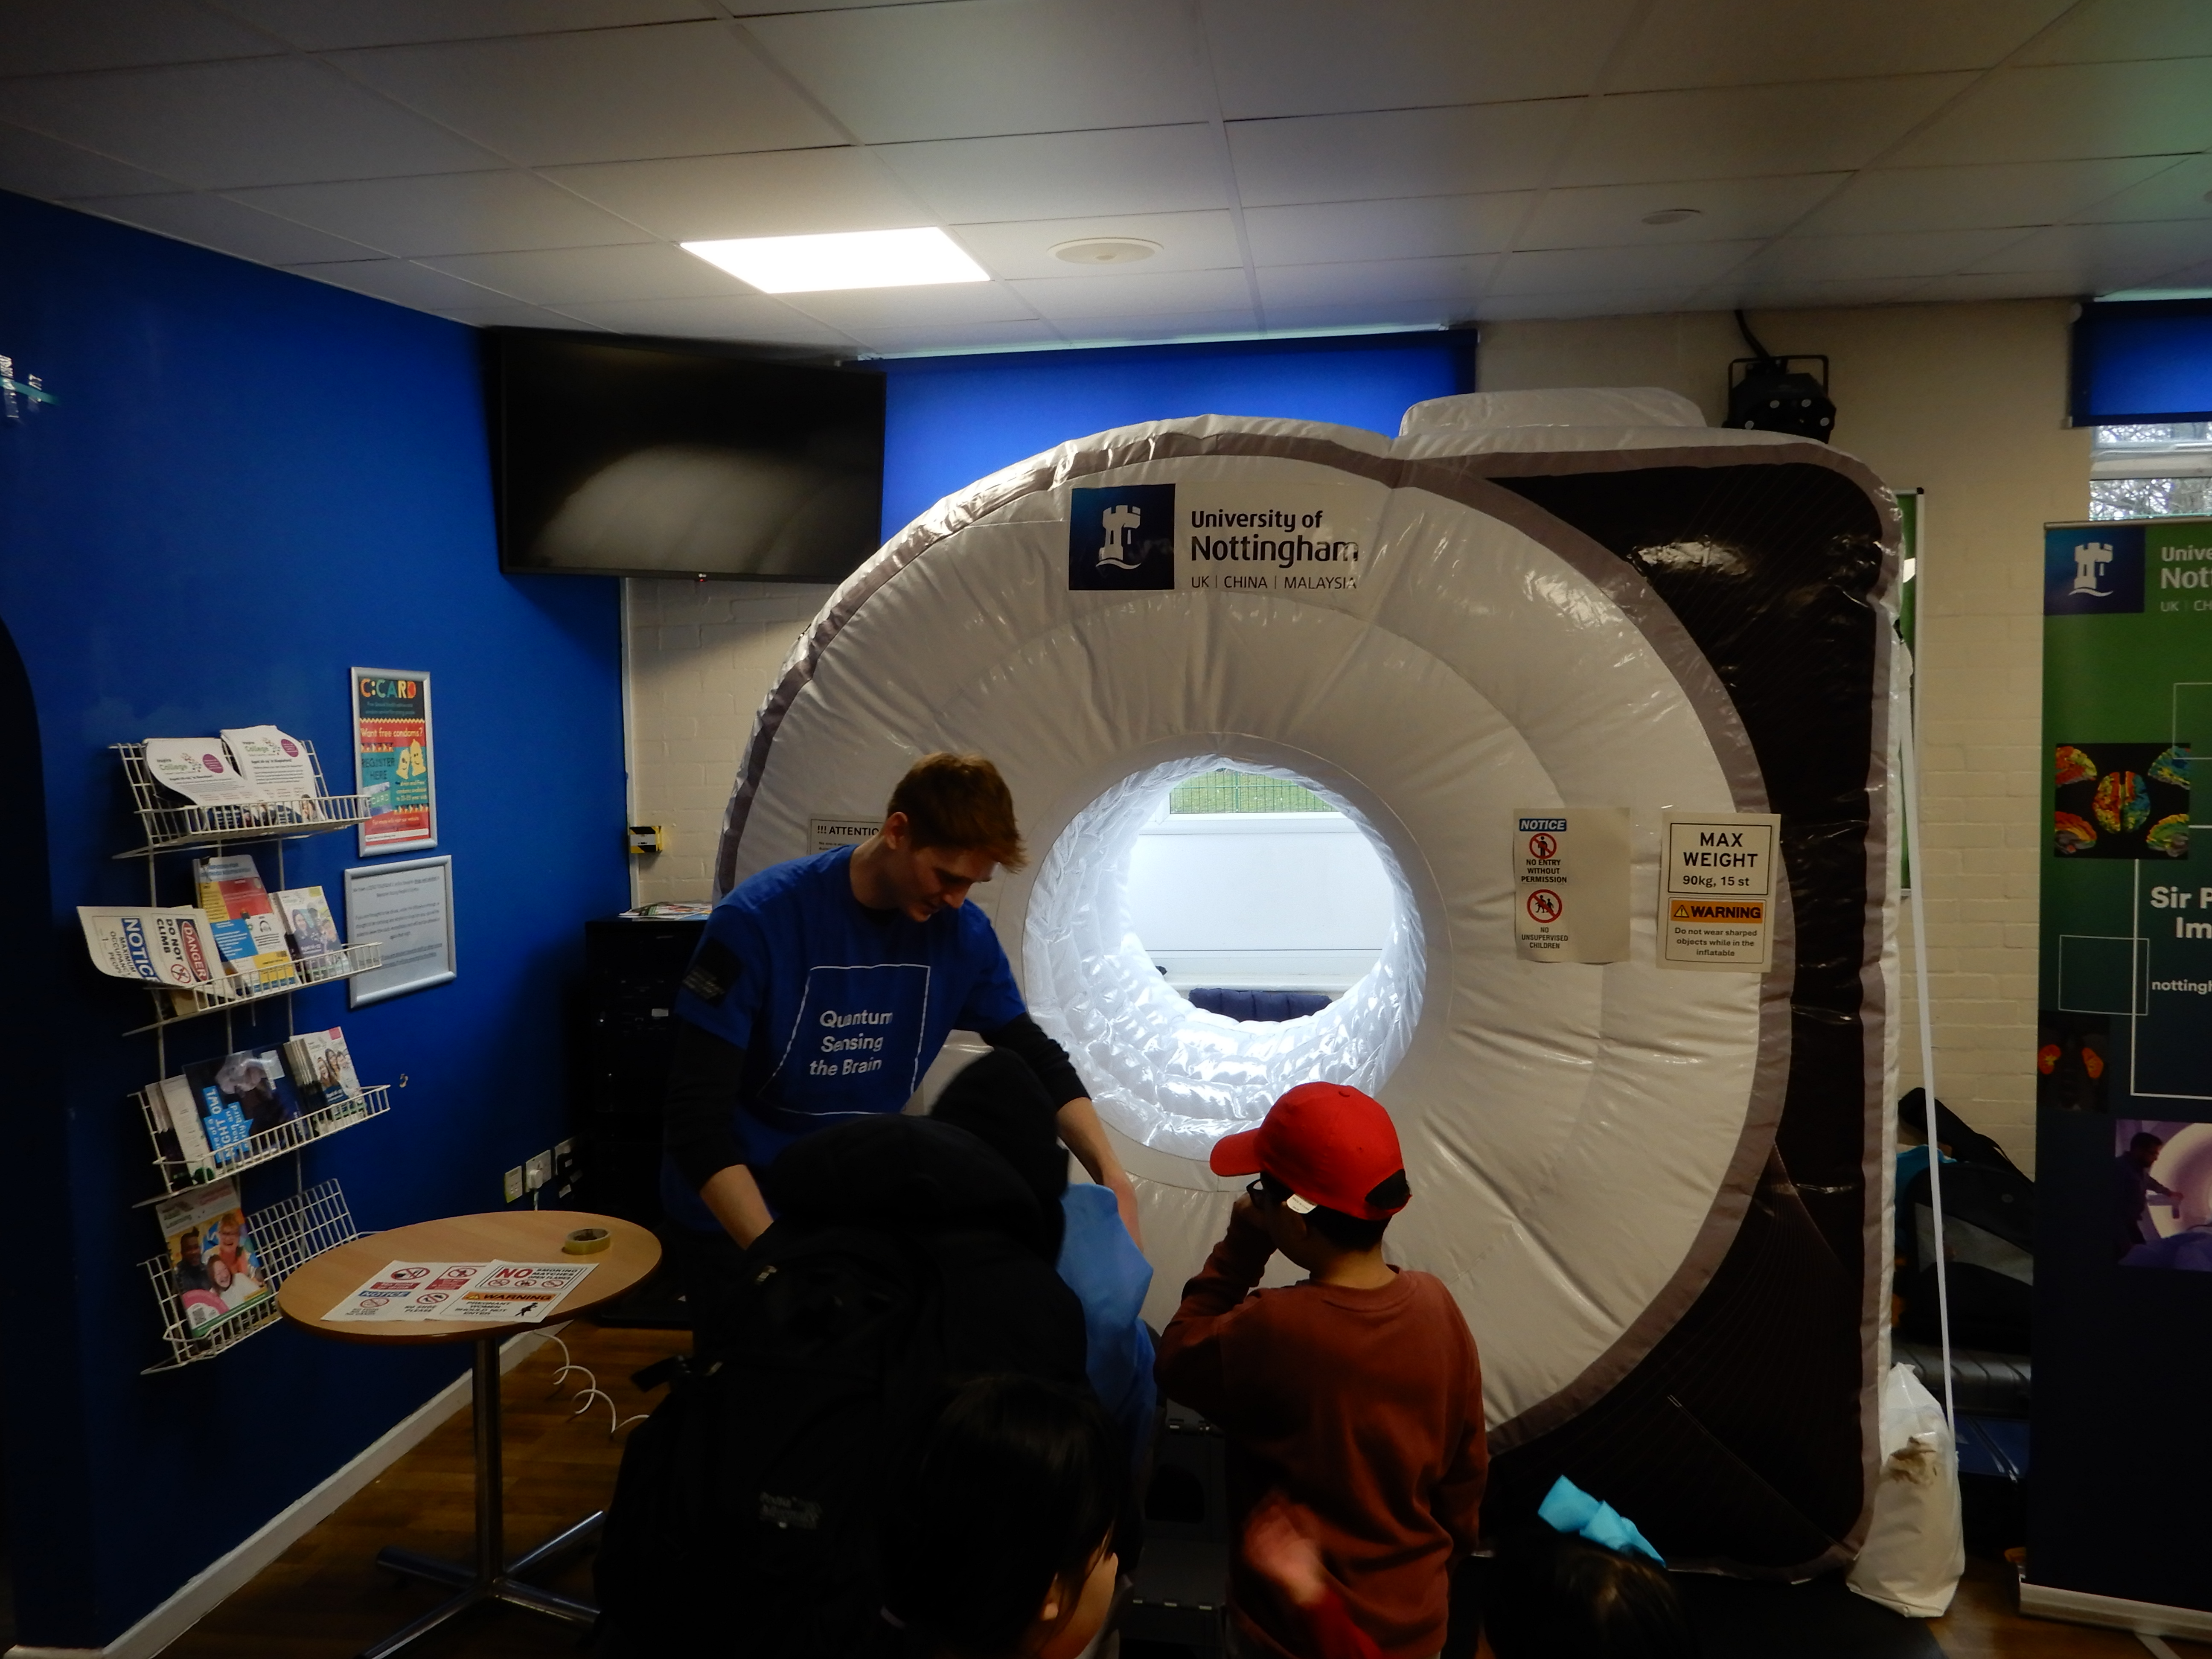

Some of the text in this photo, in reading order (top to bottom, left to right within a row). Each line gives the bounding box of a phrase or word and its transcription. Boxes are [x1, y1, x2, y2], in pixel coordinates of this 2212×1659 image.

[1191, 509, 1323, 532] University of
[1191, 534, 1359, 568] Nottingham
[2161, 544, 2212, 562] Unive
[1191, 576, 1357, 589] UK CHINA MALAYSIA
[2161, 567, 2212, 589] Not
[2160, 600, 2212, 611] UK CH
[360, 727, 423, 737] Want free condoms?
[361, 757, 395, 768] REGISTER
[370, 770, 387, 780] HERE
[817, 825, 879, 836] !!! ATTENTIO
[1520, 820, 1566, 831] NOTICE
[1700, 832, 1743, 848] MAX
[1683, 852, 1758, 867] WEIGHT
[1682, 875, 1749, 888] 90kg, 15 st
[2150, 886, 2212, 909] Sir P
[1691, 906, 1761, 919] WARNING
[157, 918, 171, 953] CLIMB
[1725, 929, 1758, 938] sharped
[2176, 917, 2212, 939] Im
[166, 918, 183, 962] DO NOT
[1676, 938, 1707, 947] objects
[119, 937, 137, 973] MAXIMUM
[184, 927, 207, 978] DANGER
[1696, 949, 1735, 957] inflatable
[108, 952, 125, 976] PEOPL
[820, 1033, 884, 1053] Sensing
[809, 1057, 882, 1076] the Brain
[226, 1110, 233, 1122] an
[230, 1105, 242, 1123] bird
[206, 1088, 235, 1157] NGHT OWL
[495, 1268, 533, 1278] NO
